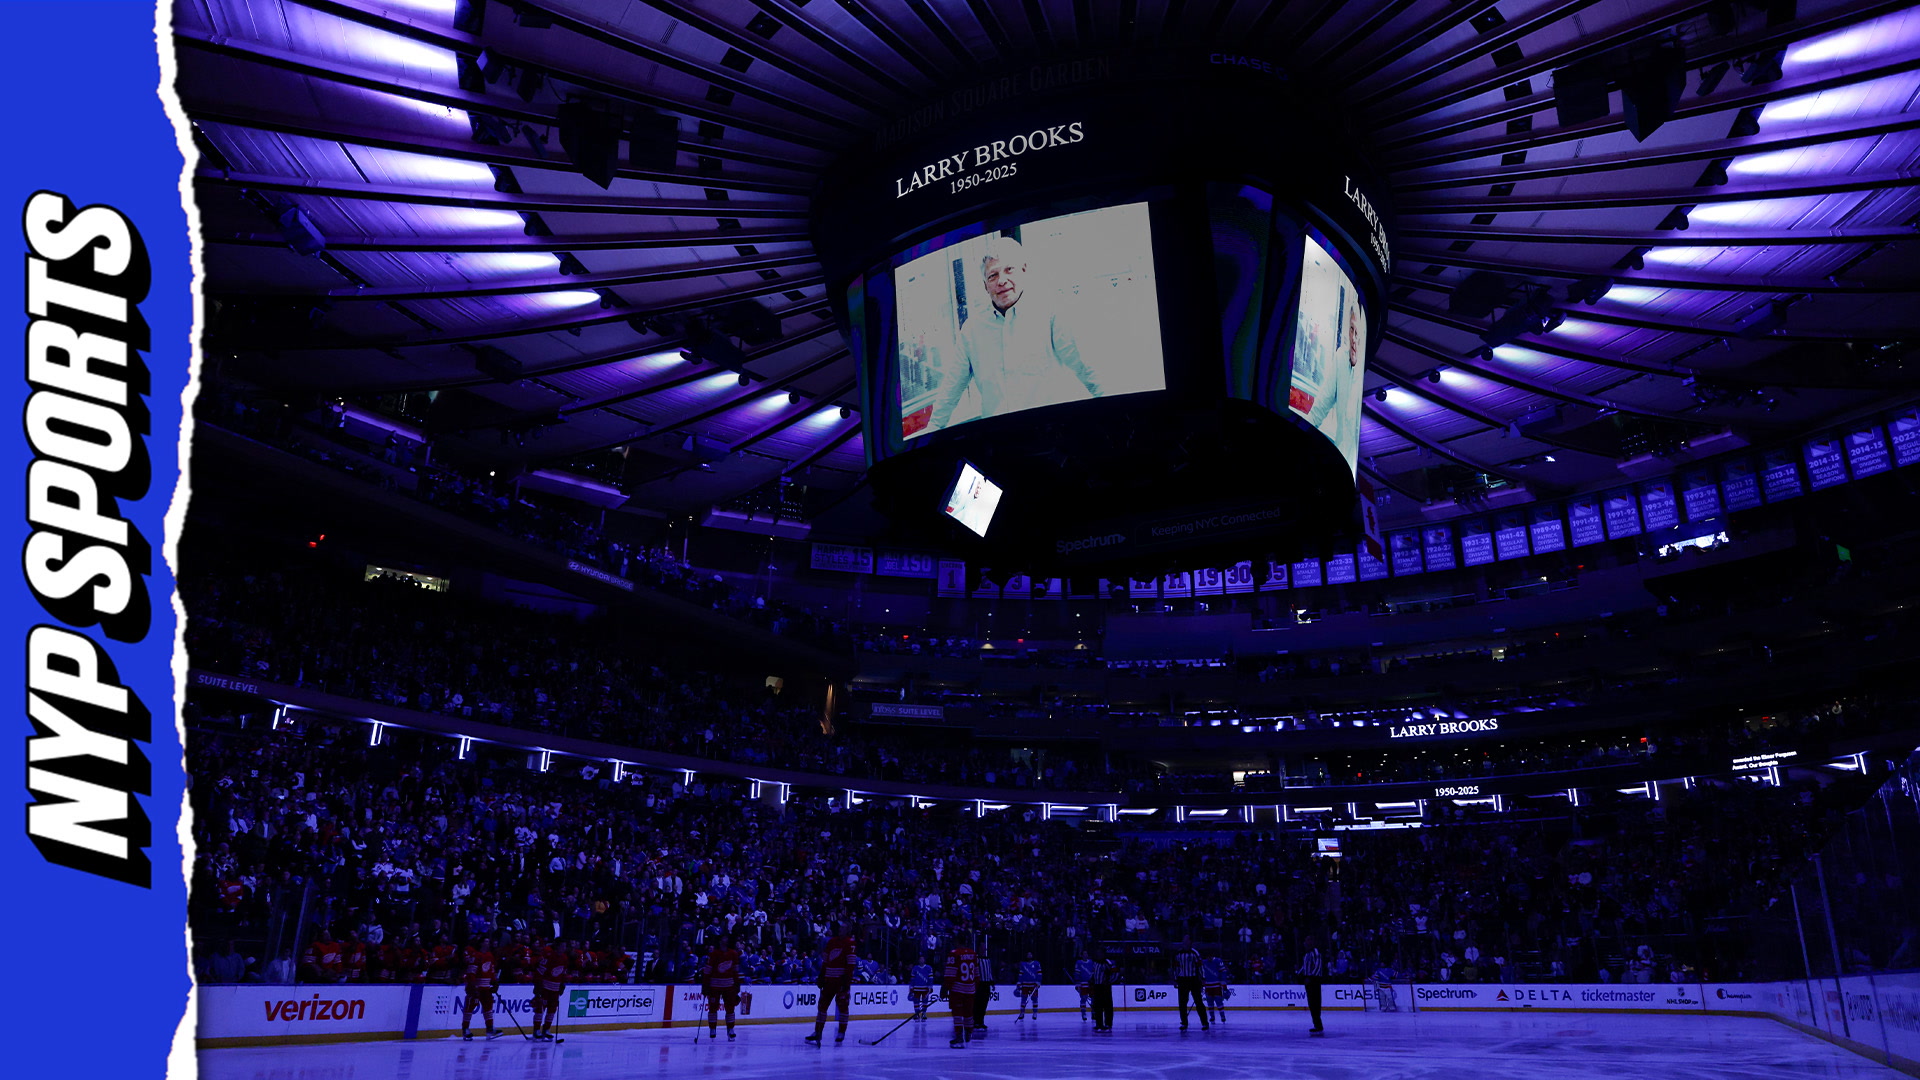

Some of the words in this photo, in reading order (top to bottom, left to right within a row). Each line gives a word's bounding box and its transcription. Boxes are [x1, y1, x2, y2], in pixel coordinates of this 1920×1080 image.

[1209, 52, 1273, 74] CHASE
[951, 71, 1022, 116] SQUARE
[1028, 55, 1111, 92] GARDEN
[896, 151, 970, 199] LARRY
[974, 121, 1085, 168] BROOKS
[950, 162, 1018, 195] 1950-2025
[1343, 175, 1379, 231] LARRY
[1851, 441, 1883, 456] 2014-15
[1809, 454, 1840, 468] 2014-15
[1765, 468, 1795, 481] 2013-14
[1726, 479, 1754, 491] 2011-12
[1686, 488, 1716, 501] 1993-94
[1645, 500, 1674, 511] 1993-94
[1608, 508, 1636, 519] 1991-92
[1151, 522, 1194, 537] Keeping
[1195, 516, 1219, 530] NYC
[1220, 507, 1281, 526] Connected
[1572, 516, 1599, 526] 1991-92
[1498, 531, 1524, 540] 1941-42
[1533, 524, 1560, 534] 1989-90
[1056, 533, 1121, 556] Spectrum
[1464, 537, 1489, 547] 1931-32
[817, 545, 846, 554] HARRY
[815, 553, 848, 565] STYLES
[853, 548, 871, 567] 15
[1328, 558, 1353, 566] 1932-33
[1198, 567, 1218, 586] 19
[1227, 564, 1251, 584] 30
[198, 674, 228, 689] SUITE
[229, 680, 259, 694] LEVEL
[898, 707, 918, 715] SUITE
[920, 708, 940, 716] LEVEL
[1390, 723, 1437, 738] LARRY
[1439, 718, 1498, 734] BROOKS
[1434, 786, 1480, 797] 1950-2025
[1132, 946, 1160, 954] ULTRA
[960, 962, 975, 981] 93
[684, 993, 688, 1001] 2
[796, 993, 817, 1006] HUB
[854, 991, 888, 1005] CHASE
[1417, 988, 1473, 1001] Spectrum
[1515, 990, 1572, 1001] DELTA
[1581, 989, 1655, 1002] ticketmaster
[1717, 988, 1752, 1003] Champion
[265, 993, 366, 1022] verizon
[574, 994, 652, 1012] enterprise
